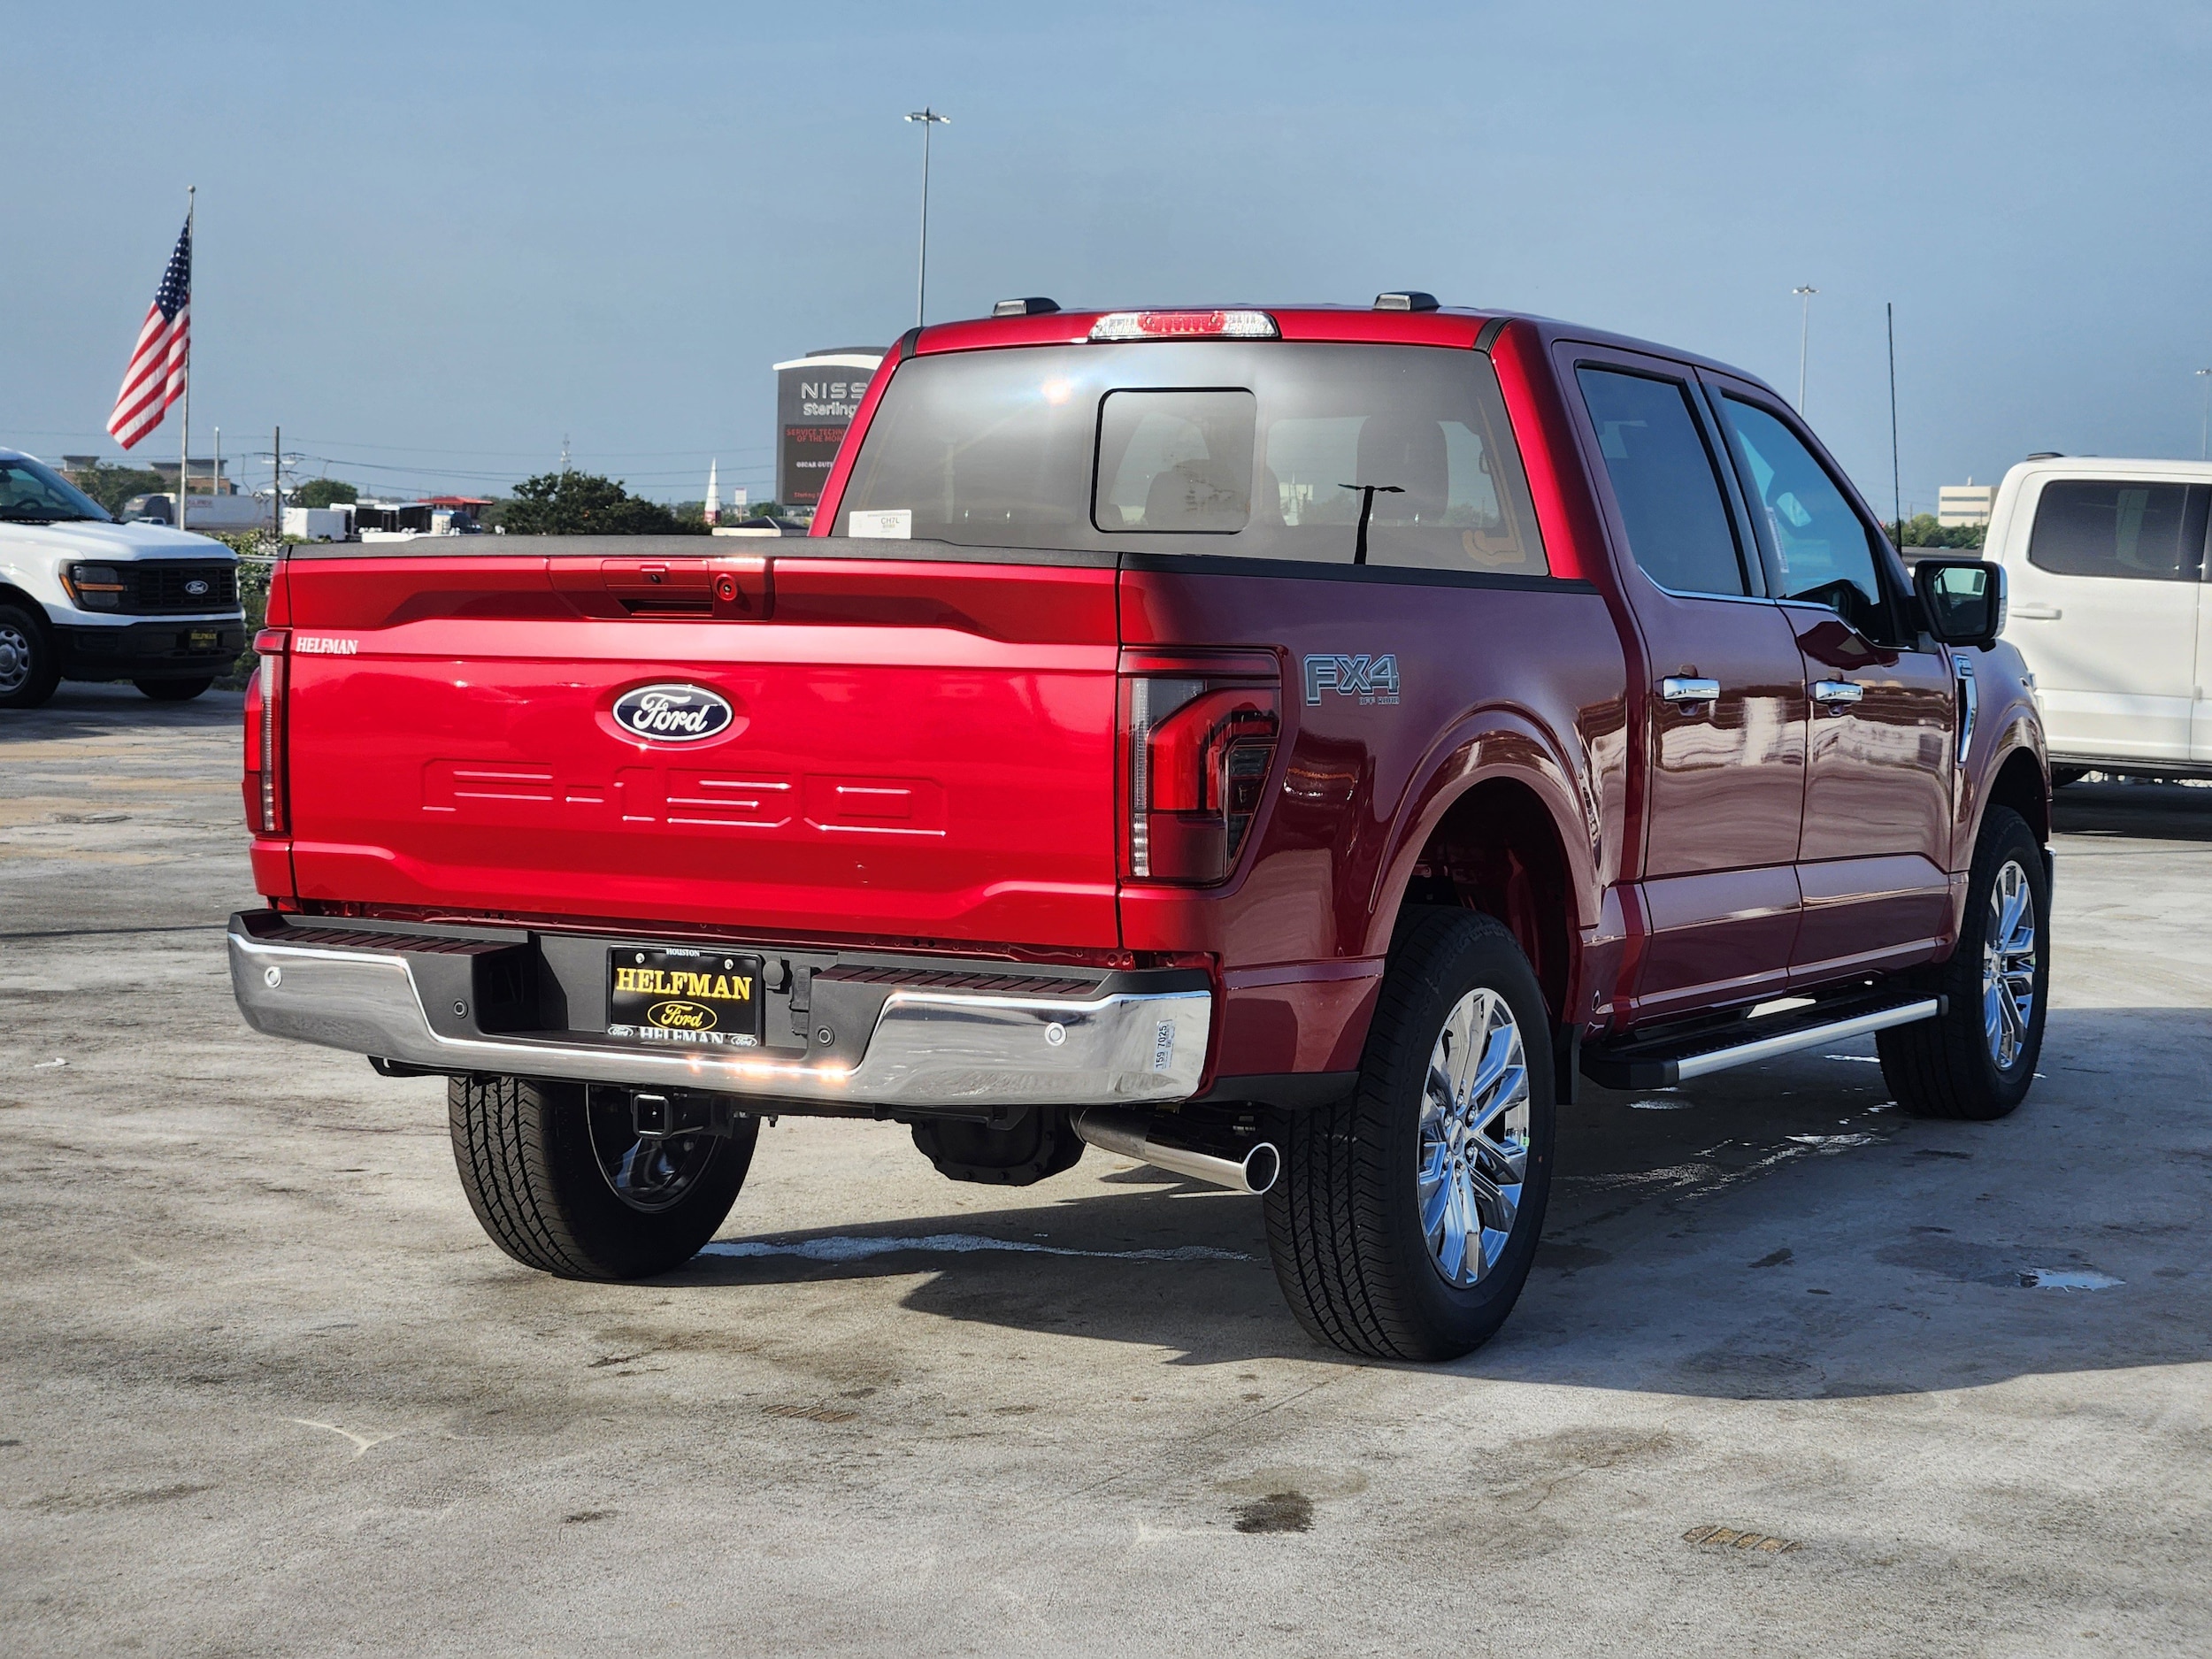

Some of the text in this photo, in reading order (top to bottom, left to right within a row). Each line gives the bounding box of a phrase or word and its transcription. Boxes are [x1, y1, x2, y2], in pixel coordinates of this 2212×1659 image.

[296, 637, 358, 655] HELFMAN
[1303, 654, 1400, 706] FX4
[633, 693, 708, 732] Ford
[420, 758, 946, 836] F-150
[665, 949, 701, 957] HOUSTON
[616, 967, 753, 1001] HELFMAN
[661, 1003, 703, 1027] Ford
